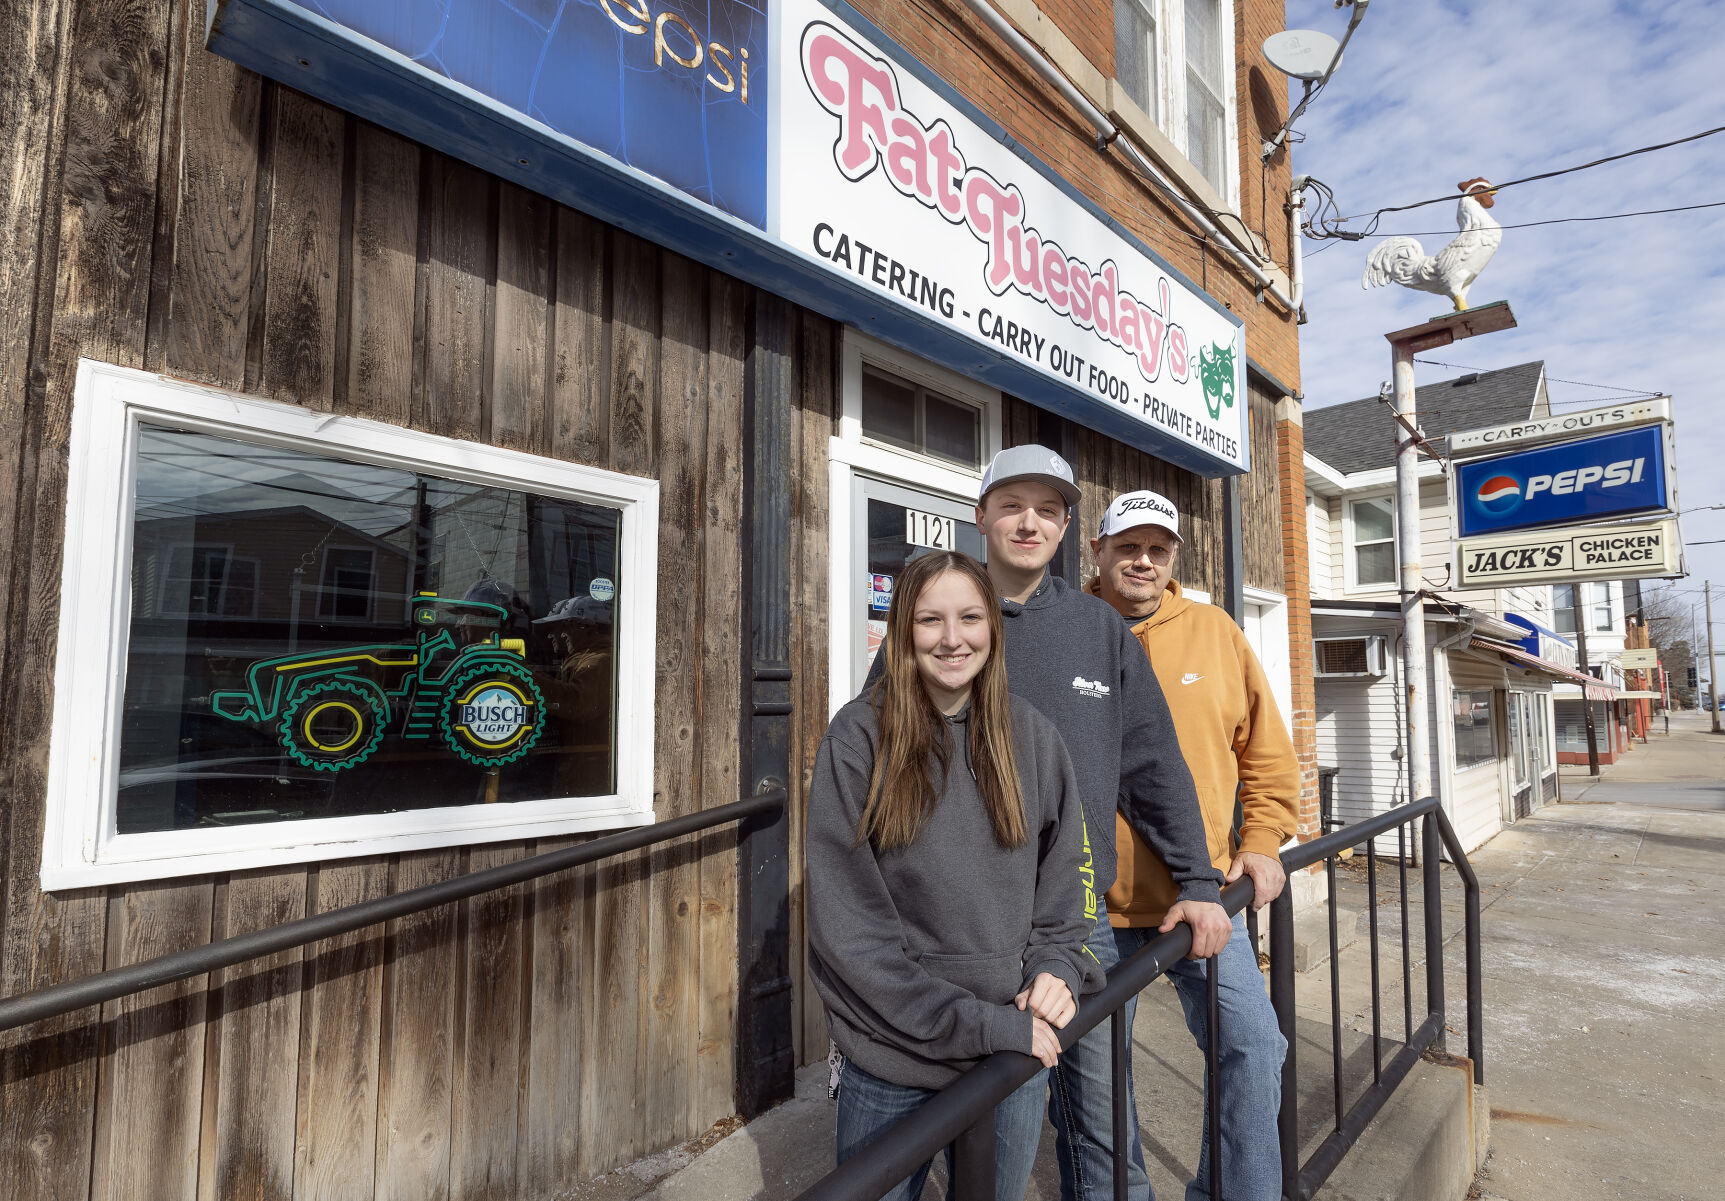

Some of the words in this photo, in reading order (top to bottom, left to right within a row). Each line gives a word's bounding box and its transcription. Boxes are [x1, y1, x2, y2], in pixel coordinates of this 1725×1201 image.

[808, 33, 962, 216] Fat
[964, 174, 1188, 378] Tuesday's
[812, 222, 955, 319] CATERING
[977, 307, 1046, 363] CARRY
[1050, 344, 1085, 383] OUT
[1088, 363, 1130, 405] FOOD
[1143, 393, 1192, 438] PRIVATE
[1195, 421, 1238, 459] PARTIES
[1482, 422, 1550, 443] CARRY
[1562, 409, 1625, 429] OUTS
[1525, 457, 1645, 501] PEPSI
[1117, 497, 1175, 519] Titleist
[910, 511, 951, 550] 1121
[1579, 535, 1660, 553] CHICKEN
[1467, 545, 1564, 573] JACK'S
[1586, 548, 1653, 565] PALACE
[876, 595, 890, 604] VISA
[1184, 672, 1199, 680] NIKE
[463, 704, 526, 724] BUSCH
[476, 723, 513, 733] LIGHT
